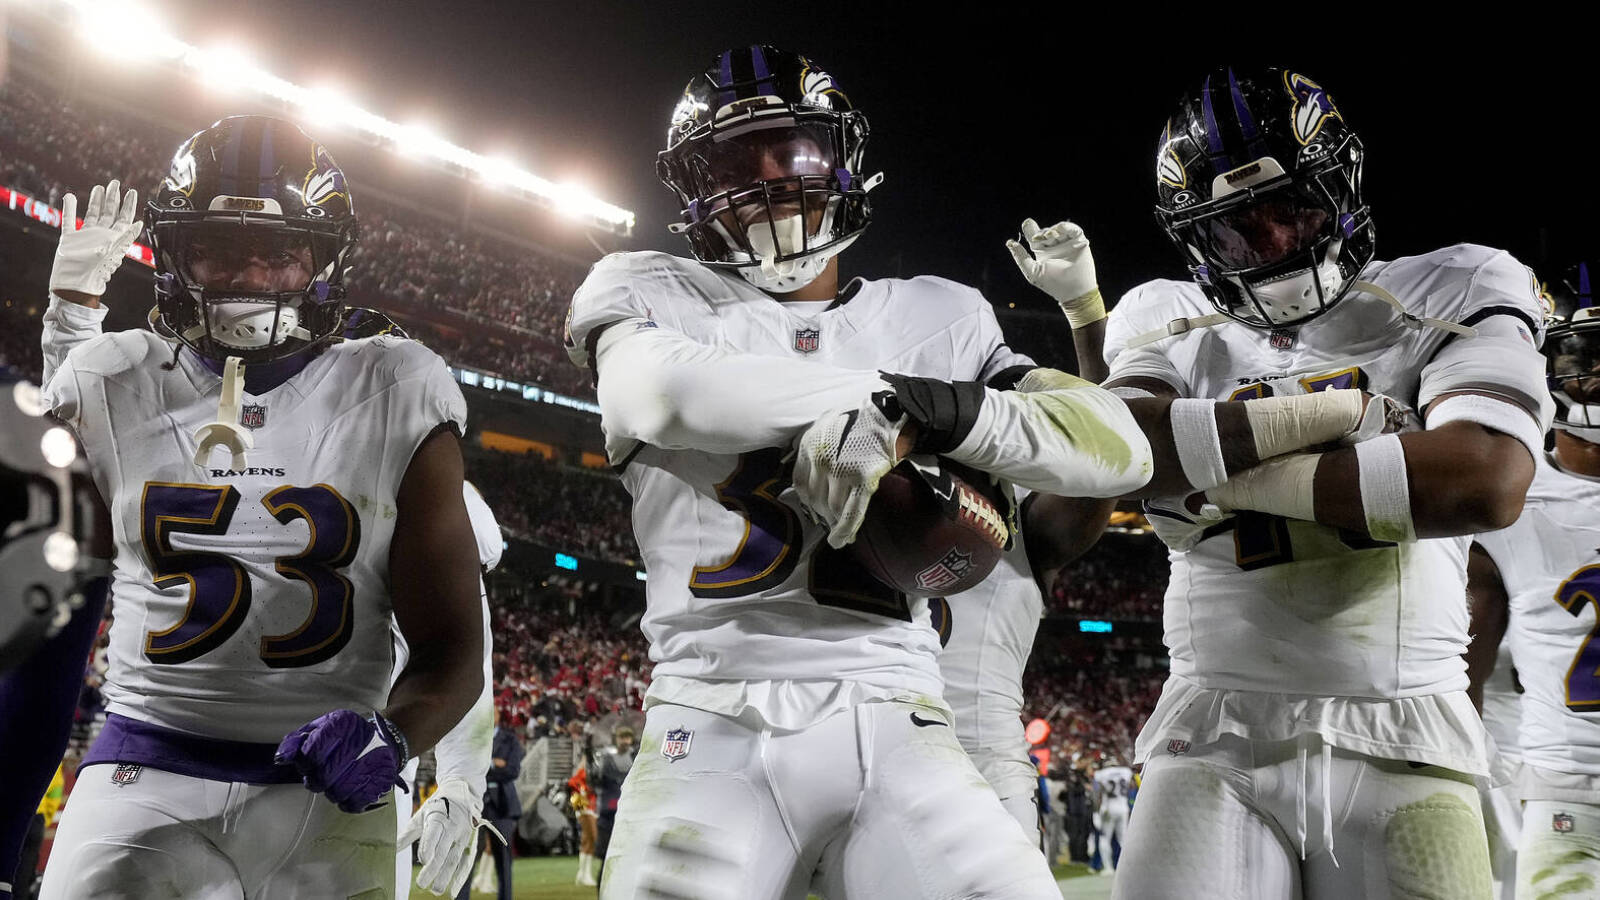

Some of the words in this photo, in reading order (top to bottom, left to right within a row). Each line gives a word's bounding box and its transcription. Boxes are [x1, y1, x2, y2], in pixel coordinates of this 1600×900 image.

[797, 337, 817, 350] NFL
[1271, 335, 1291, 348] NFL
[243, 413, 263, 425] NFL
[210, 467, 286, 477] RAVENS
[140, 481, 361, 668] 53
[920, 563, 959, 588] NFL
[664, 741, 685, 756] NFL
[115, 770, 136, 781] NFL
